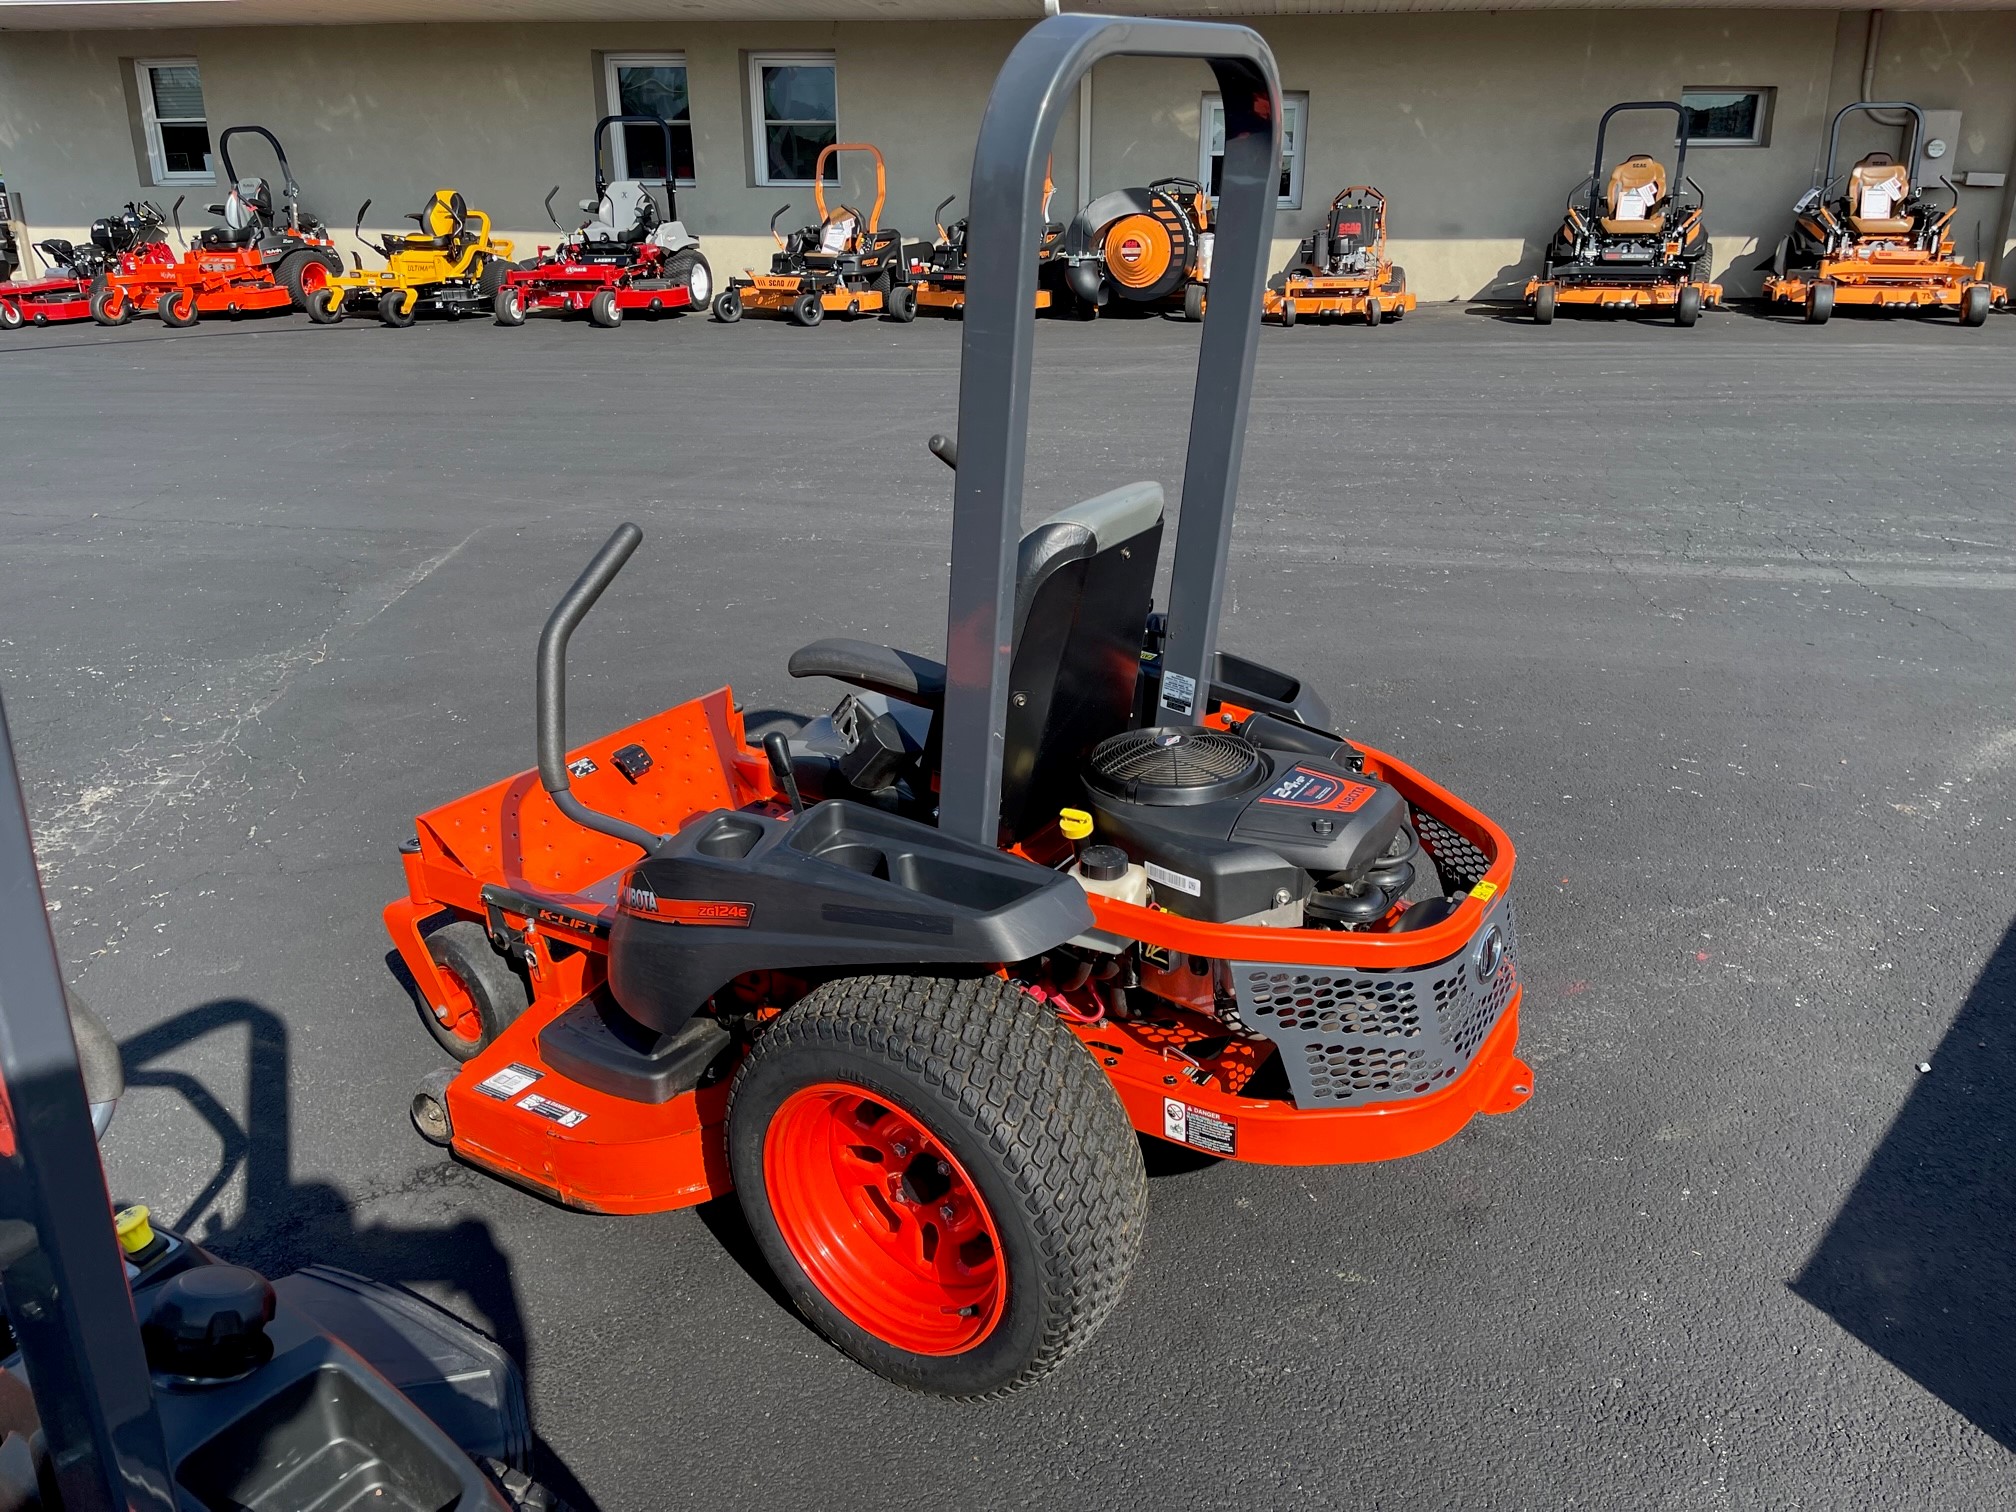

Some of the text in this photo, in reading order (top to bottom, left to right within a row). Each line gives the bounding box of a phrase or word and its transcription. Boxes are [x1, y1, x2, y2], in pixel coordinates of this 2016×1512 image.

[1336, 786, 1368, 810] KUBOTA
[698, 905, 748, 918] ZG124E
[540, 909, 599, 934] K-LIFT
[1194, 1108, 1220, 1119] DANGER
